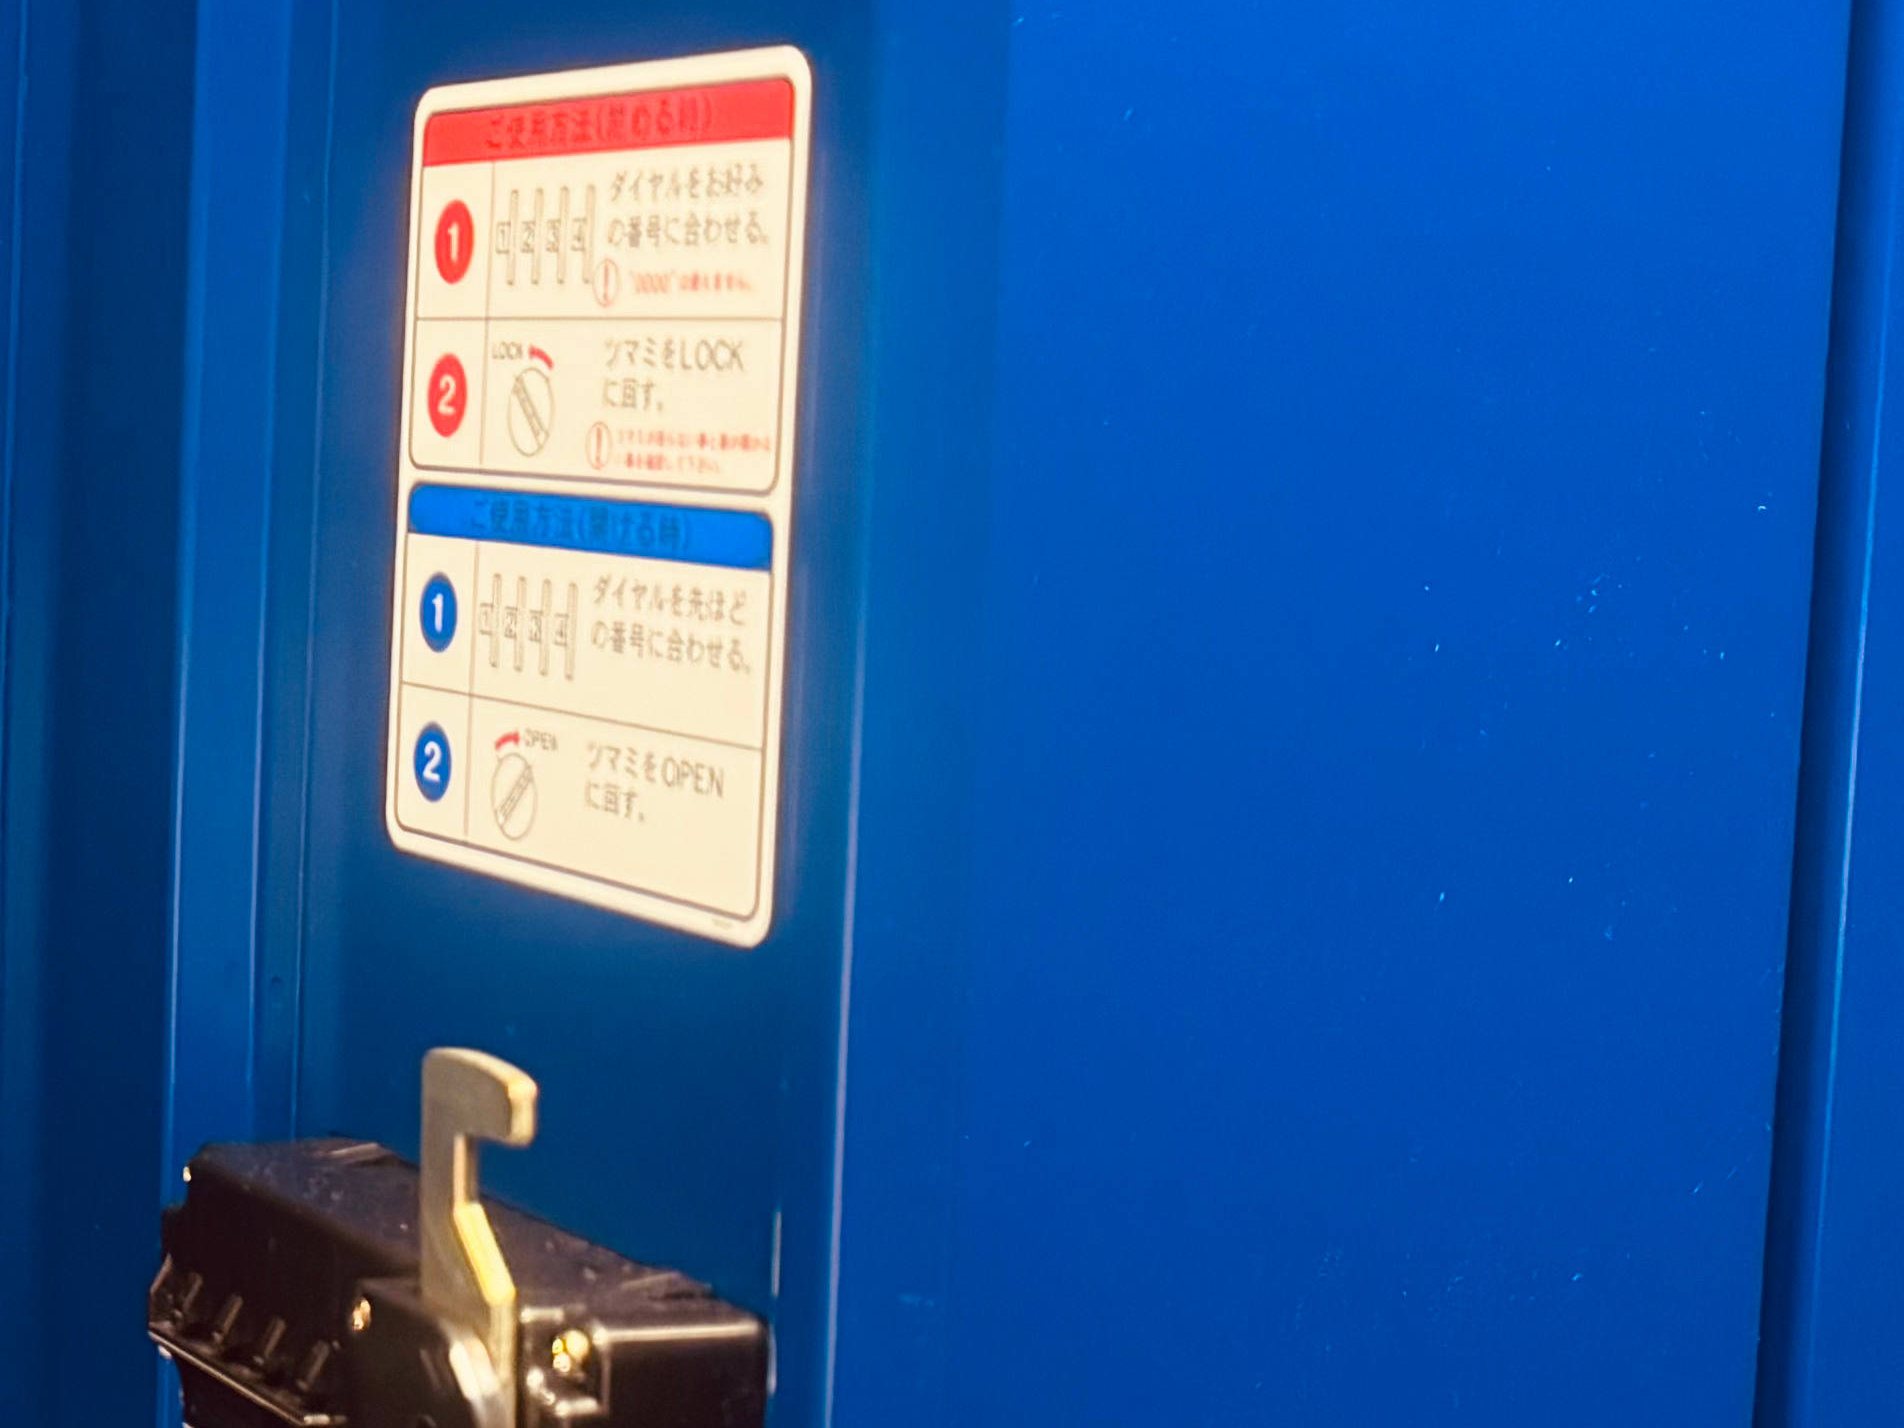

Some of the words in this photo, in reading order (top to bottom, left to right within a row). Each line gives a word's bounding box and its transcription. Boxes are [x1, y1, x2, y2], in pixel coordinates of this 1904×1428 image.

[447, 221, 460, 263] 1
[492, 342, 524, 360] LOCK
[437, 375, 456, 415] 2
[431, 592, 444, 633] 1
[422, 740, 442, 783] 2
